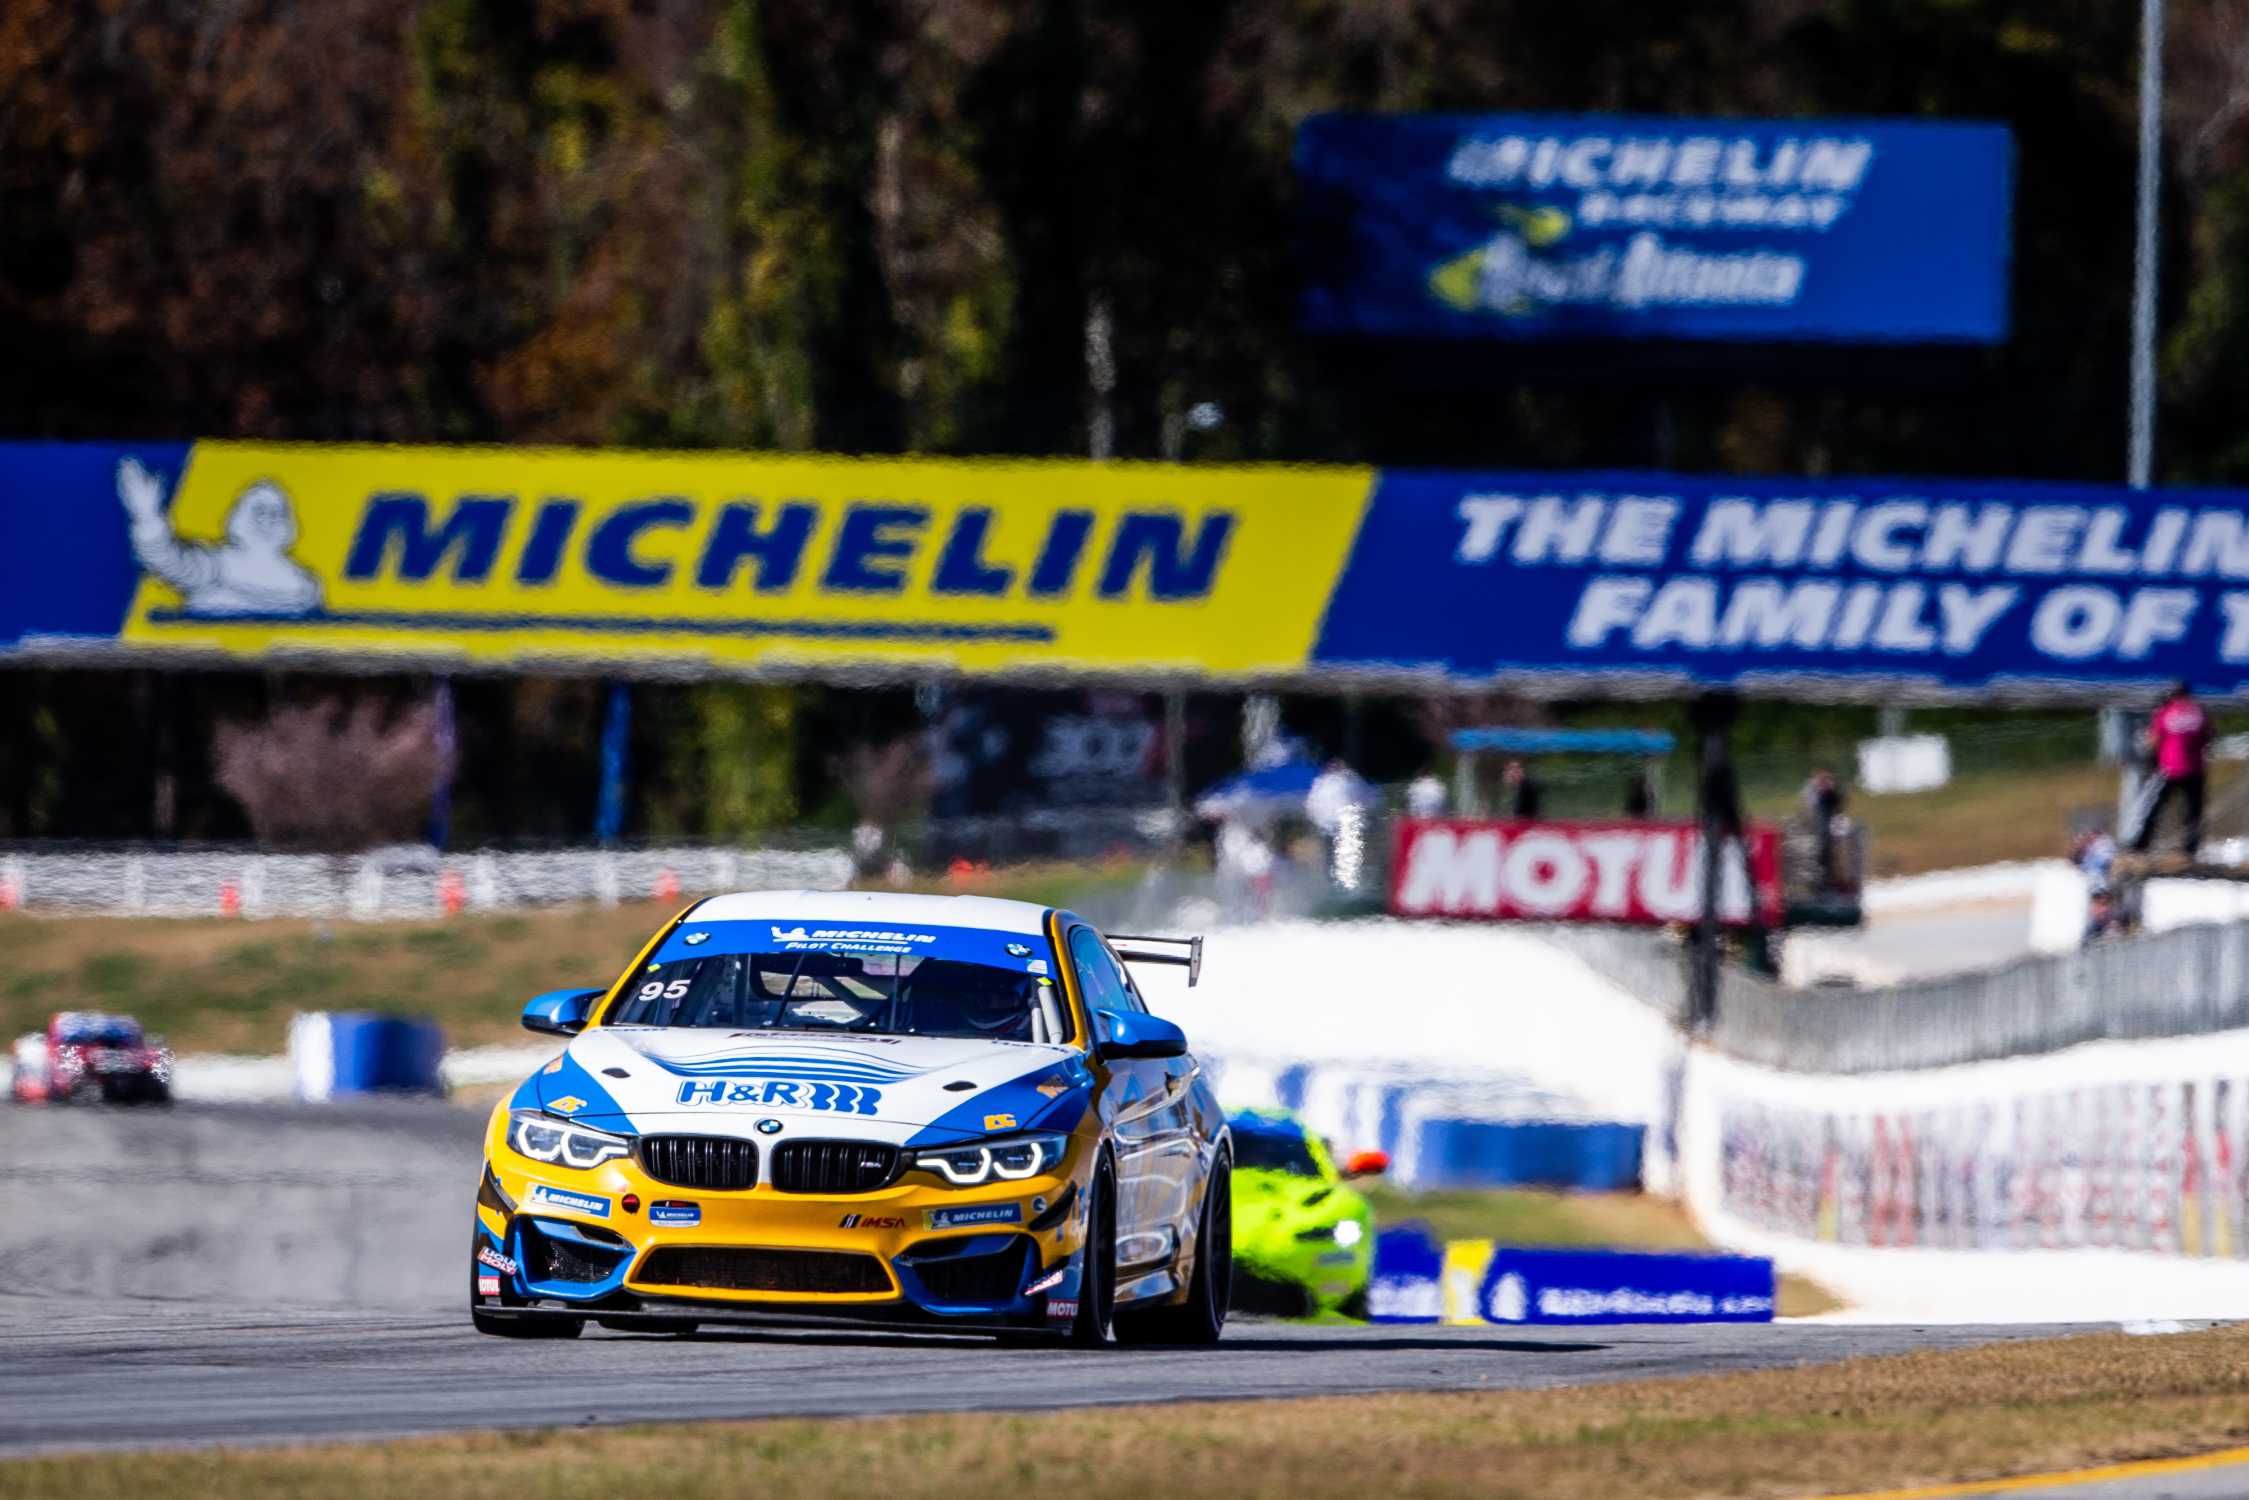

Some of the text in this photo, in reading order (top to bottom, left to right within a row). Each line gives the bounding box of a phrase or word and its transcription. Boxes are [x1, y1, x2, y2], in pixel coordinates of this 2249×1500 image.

[1448, 134, 1873, 190] MICHELIN
[1453, 494, 1680, 566] THE
[342, 490, 1240, 602] MICHELIN
[1565, 573, 2018, 657] FAMILY
[2029, 583, 2198, 661] OF
[811, 929, 937, 944] MICHELIN
[638, 979, 692, 1001] 95
[677, 1079, 806, 1106] H&R
[547, 1193, 605, 1211] MICHELIN
[860, 1216, 905, 1229] IMSA
[952, 1209, 1014, 1222] MICHELIN
